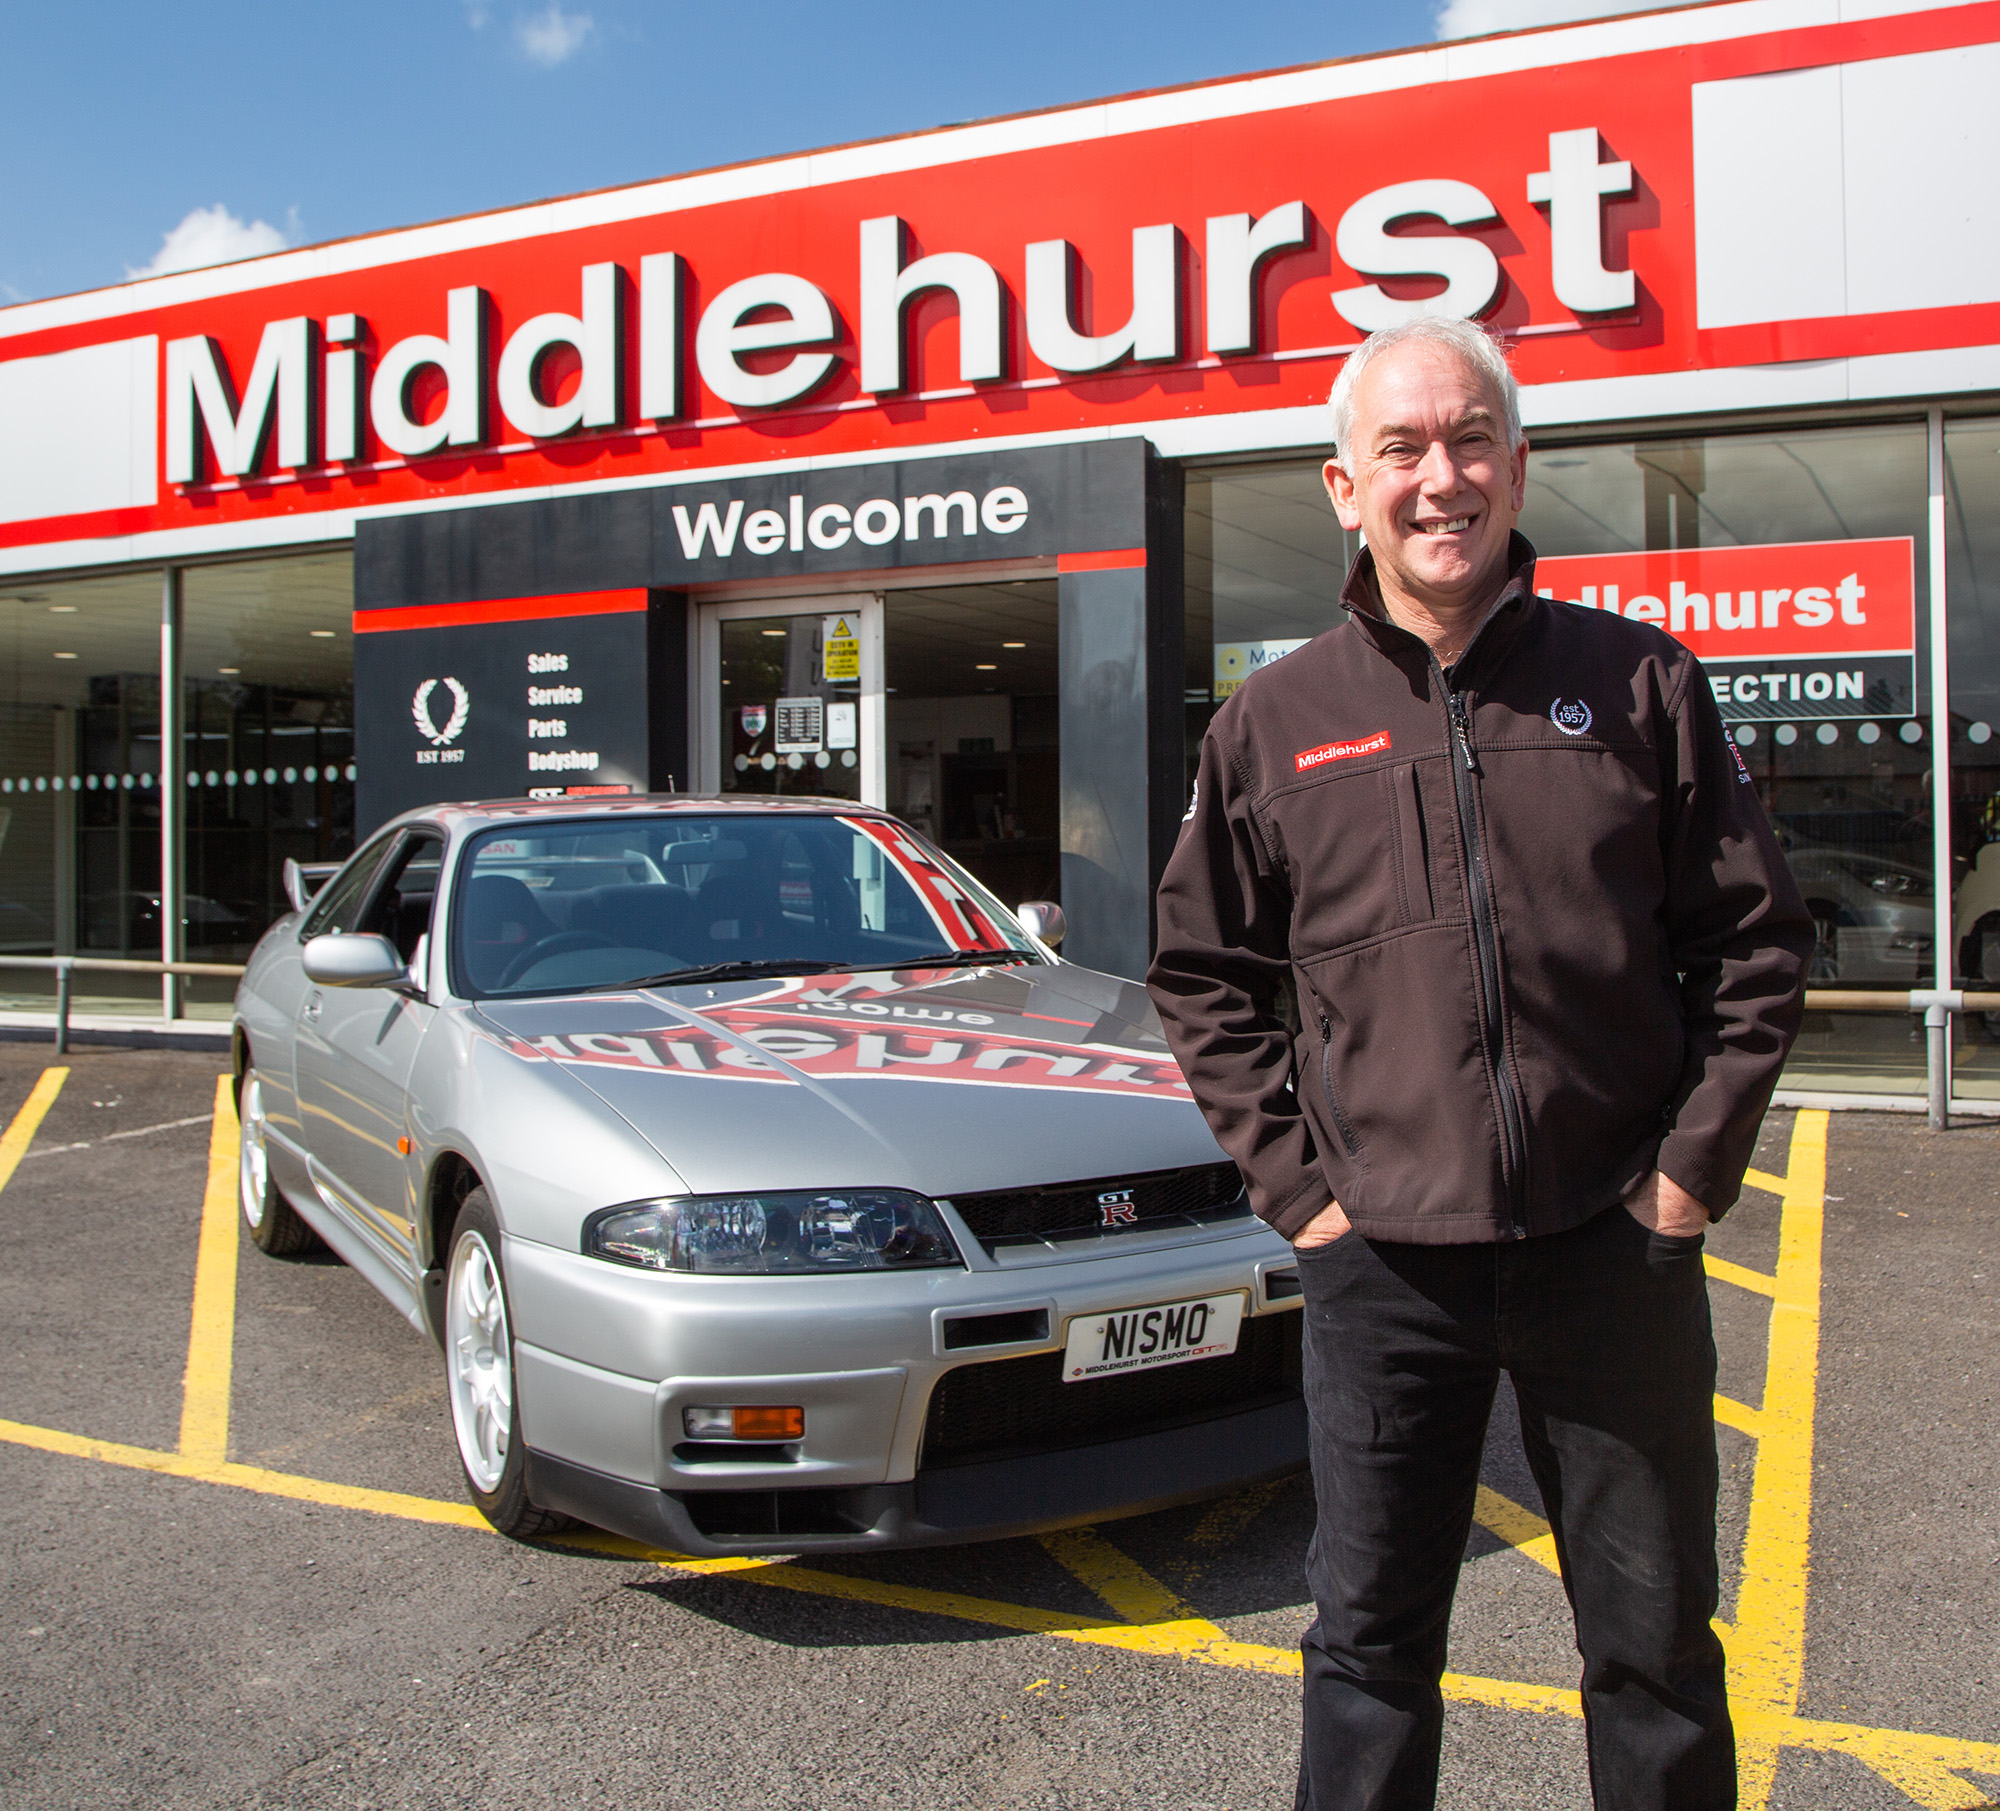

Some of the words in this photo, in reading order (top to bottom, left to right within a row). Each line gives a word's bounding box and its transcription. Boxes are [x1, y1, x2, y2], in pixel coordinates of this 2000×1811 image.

[165, 127, 1637, 486] Middlehurst
[671, 485, 1029, 560] Welcome
[527, 653, 569, 674] Sales
[527, 685, 584, 706] Service
[1559, 711, 1586, 724] 1957
[1562, 704, 1579, 713] est
[528, 718, 568, 738] Parts
[416, 751, 440, 764] EST
[528, 751, 600, 772] Bodyshop
[1298, 736, 1386, 768] Middlehurst
[1101, 1202, 1139, 1227] R
[1101, 1302, 1209, 1361] NISMO
[1085, 1359, 1139, 1374] MIDDLEHURST
[1140, 1350, 1192, 1365] MOTORSPORT
